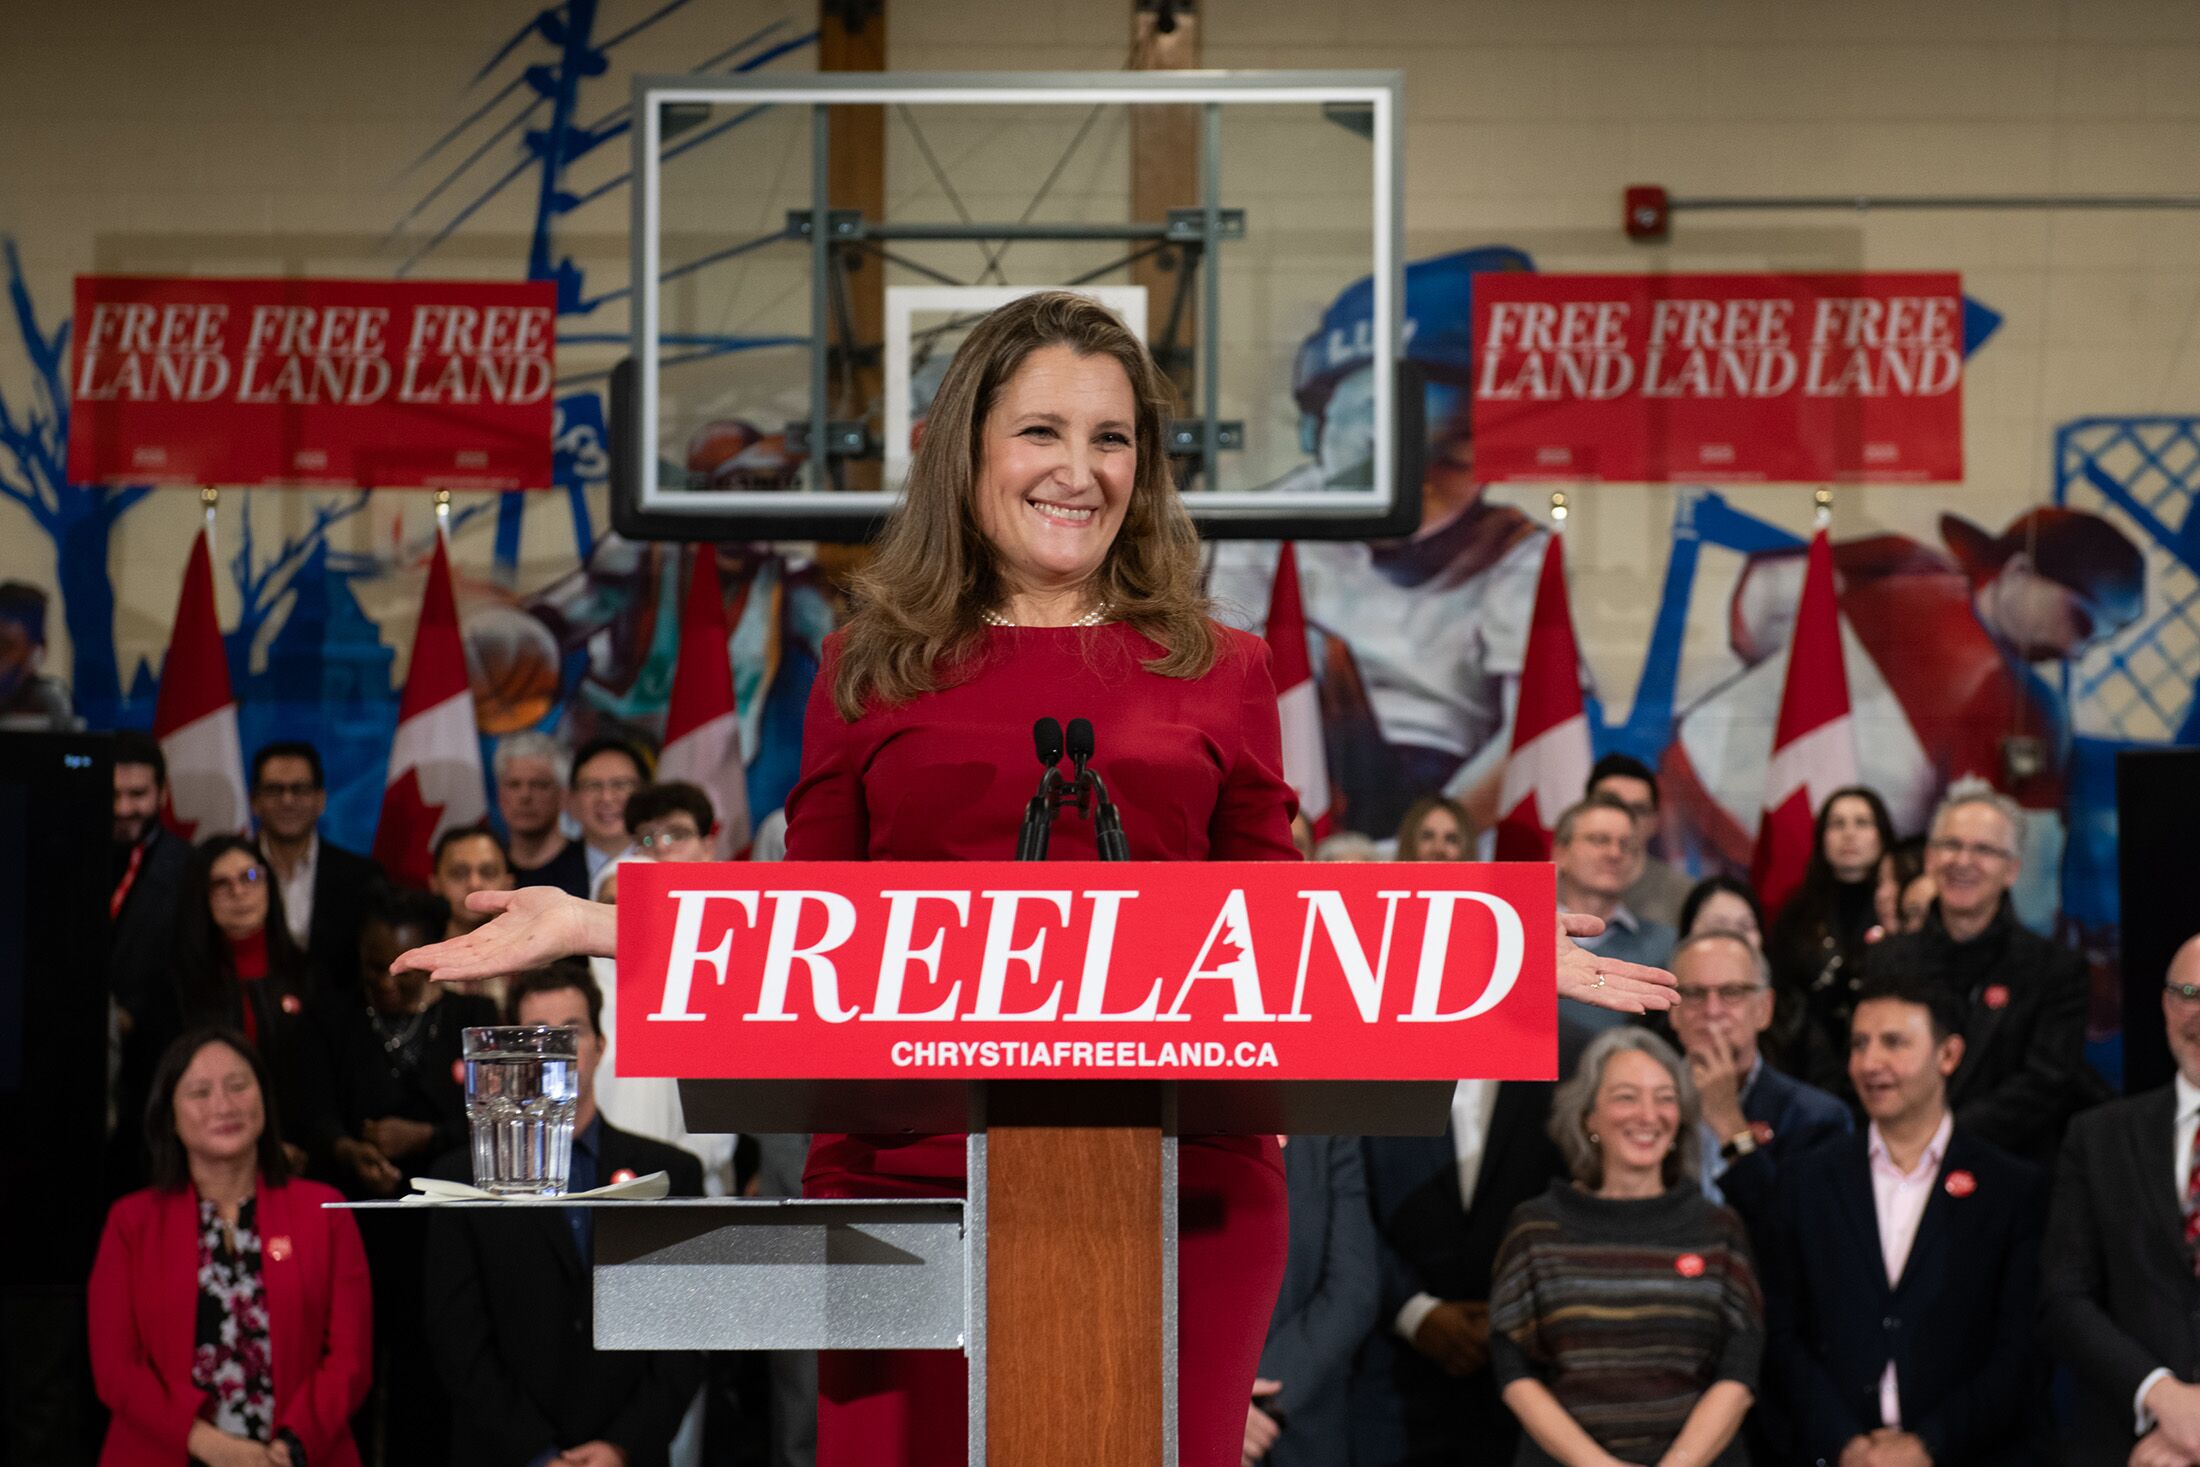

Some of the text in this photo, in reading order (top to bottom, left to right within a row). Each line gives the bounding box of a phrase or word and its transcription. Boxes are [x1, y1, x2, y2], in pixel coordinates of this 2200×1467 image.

[86, 304, 229, 352] FREE
[246, 304, 390, 356] FREE
[408, 304, 551, 356] FREE
[1486, 301, 1631, 351] FREE
[1650, 298, 1796, 348] FREE
[1813, 296, 1959, 346] FREE
[77, 351, 231, 401] LAND
[237, 355, 392, 405] LAND
[399, 355, 553, 405] LAND
[1476, 349, 1635, 400] LAND
[1642, 347, 1798, 398] LAND
[1806, 345, 1962, 397] LAND
[647, 889, 1525, 1024] FREELAND
[891, 1041, 1279, 1067] CHRYSTIAFREELAND.CA
